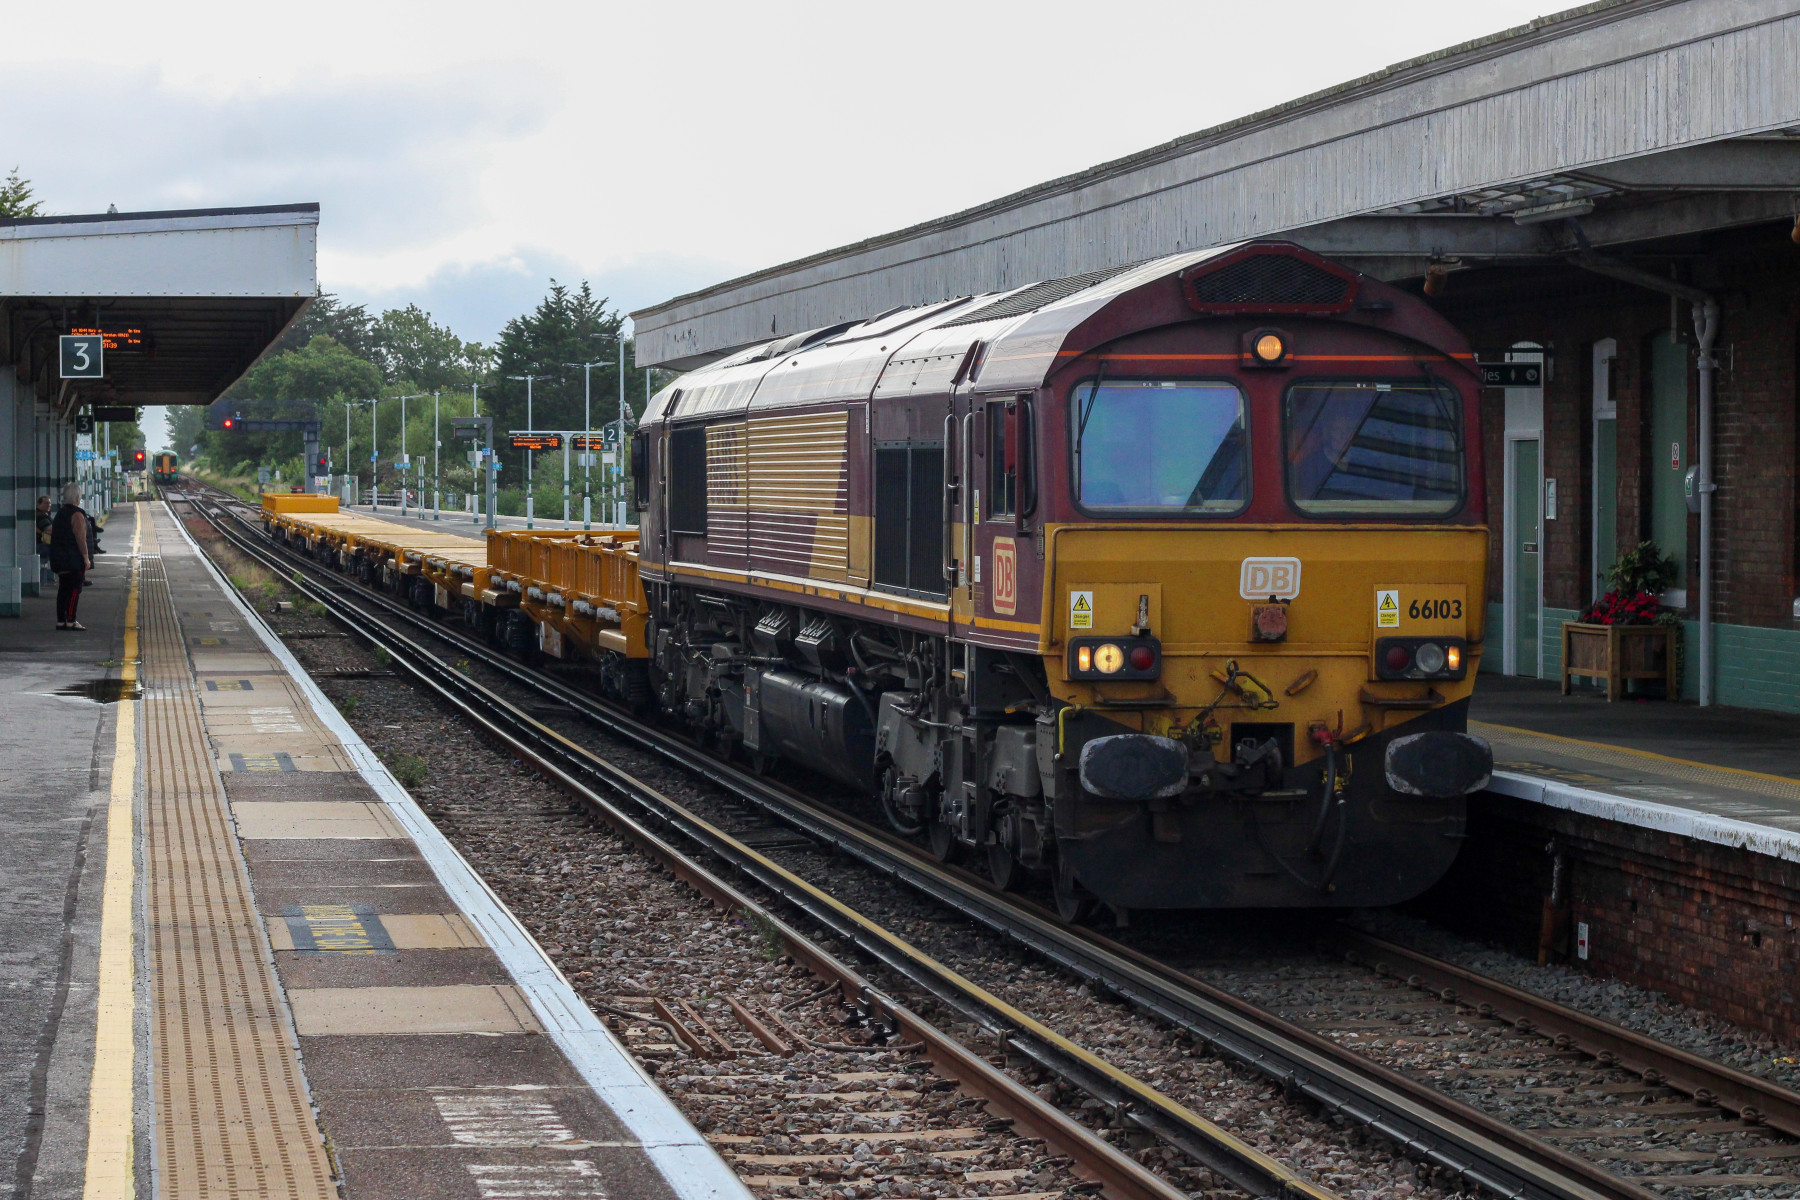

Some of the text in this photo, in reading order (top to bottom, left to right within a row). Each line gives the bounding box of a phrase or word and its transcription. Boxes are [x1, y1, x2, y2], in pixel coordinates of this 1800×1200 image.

[73, 342, 90, 370] 3
[1481, 367, 1500, 381] ies
[80, 417, 89, 431] 3
[608, 428, 615, 441] 2
[1408, 599, 1463, 619] 66103
[308, 922, 367, 937] THE
[314, 938, 376, 955] GAP
[465, 1159, 607, 1200] TH
